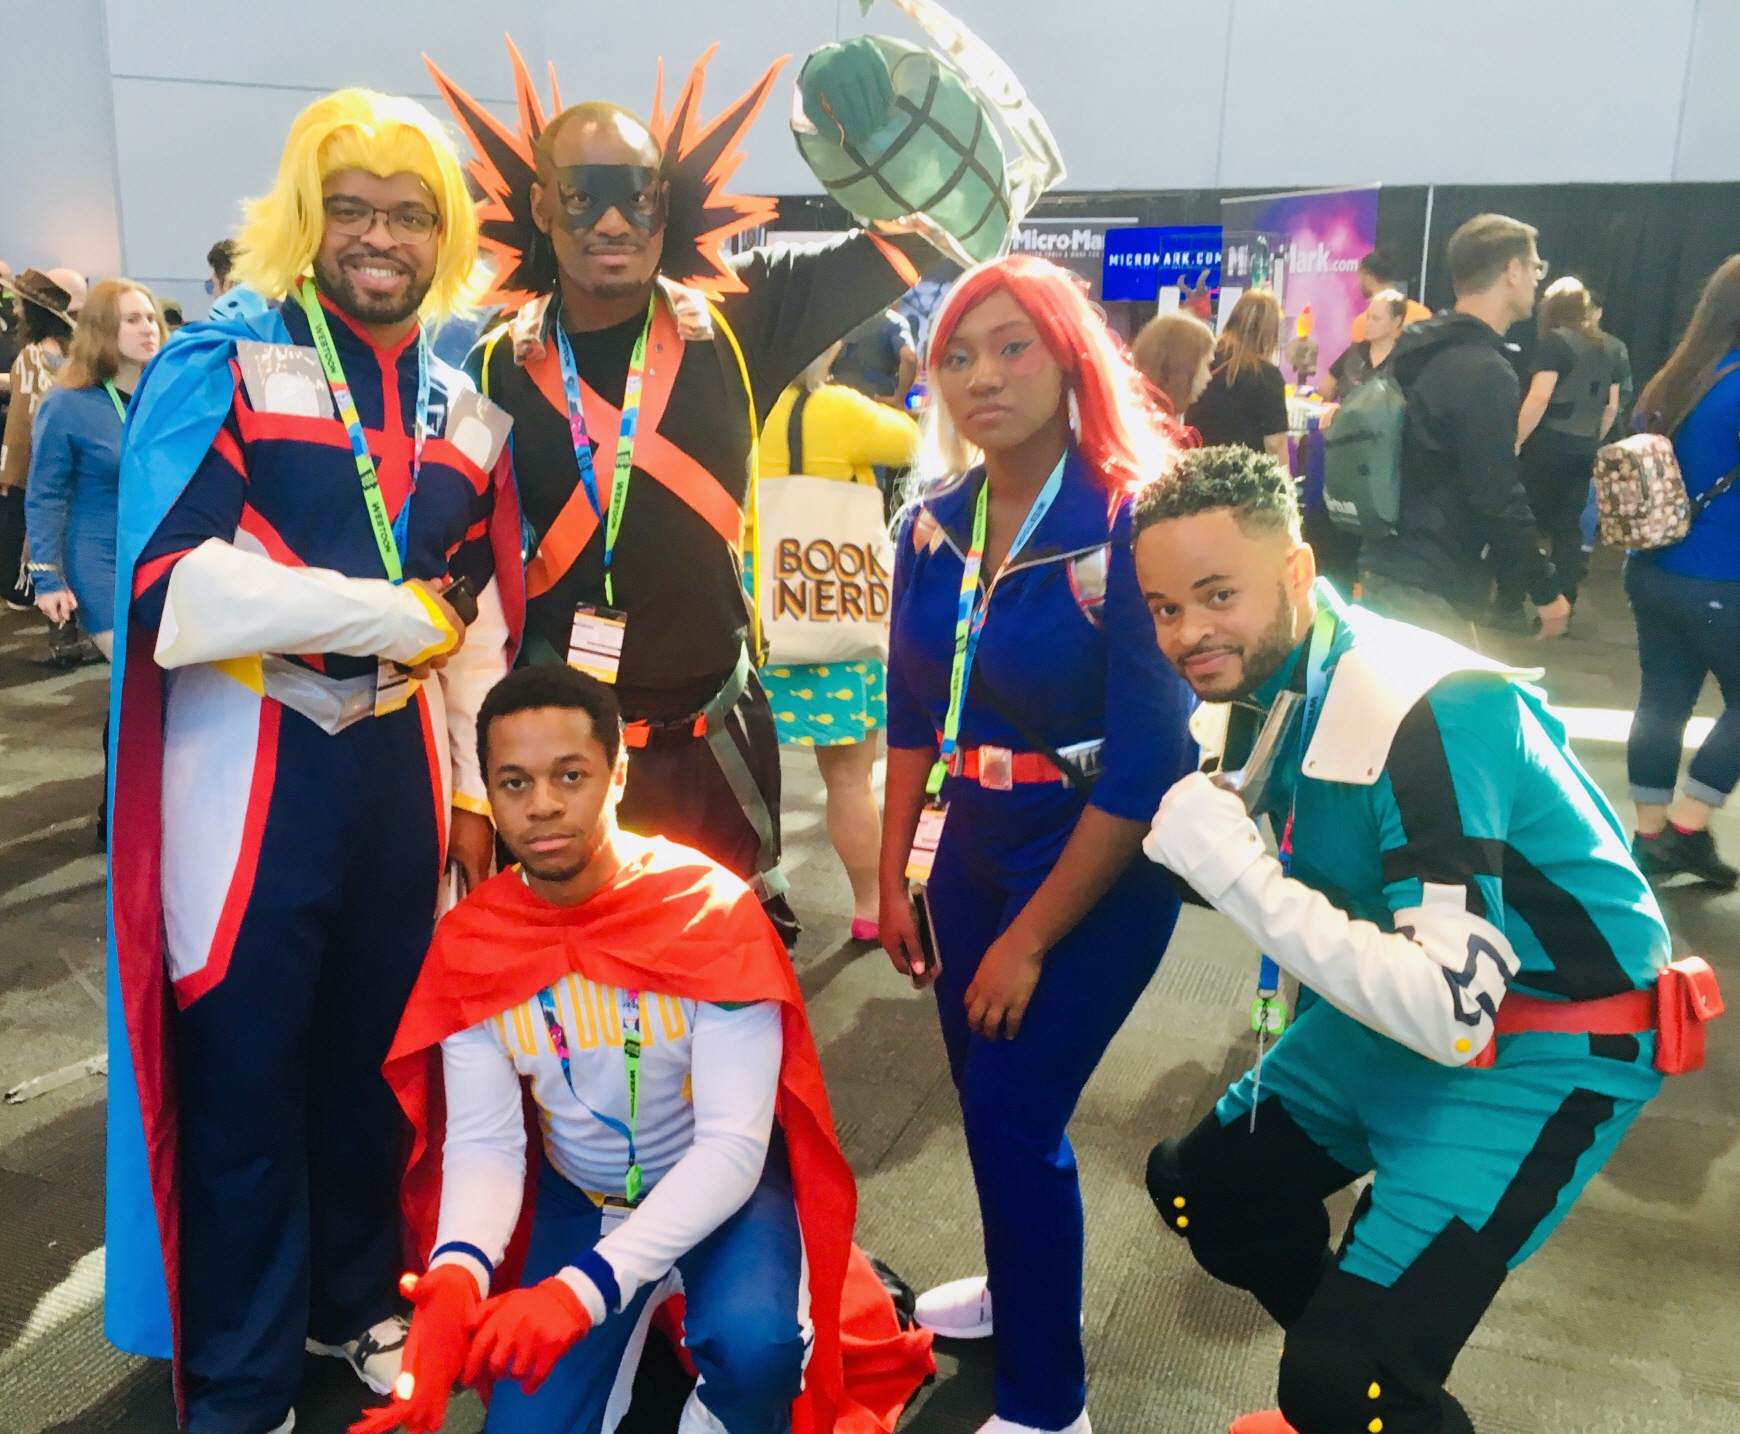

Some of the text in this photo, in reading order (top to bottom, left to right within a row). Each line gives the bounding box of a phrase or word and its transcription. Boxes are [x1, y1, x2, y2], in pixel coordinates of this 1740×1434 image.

[315, 322, 337, 374] WEBTOON
[372, 501, 392, 553] WEBTOON
[611, 481, 624, 529] WEBTOON
[774, 538, 889, 583] BOOK
[773, 579, 889, 622] NERD
